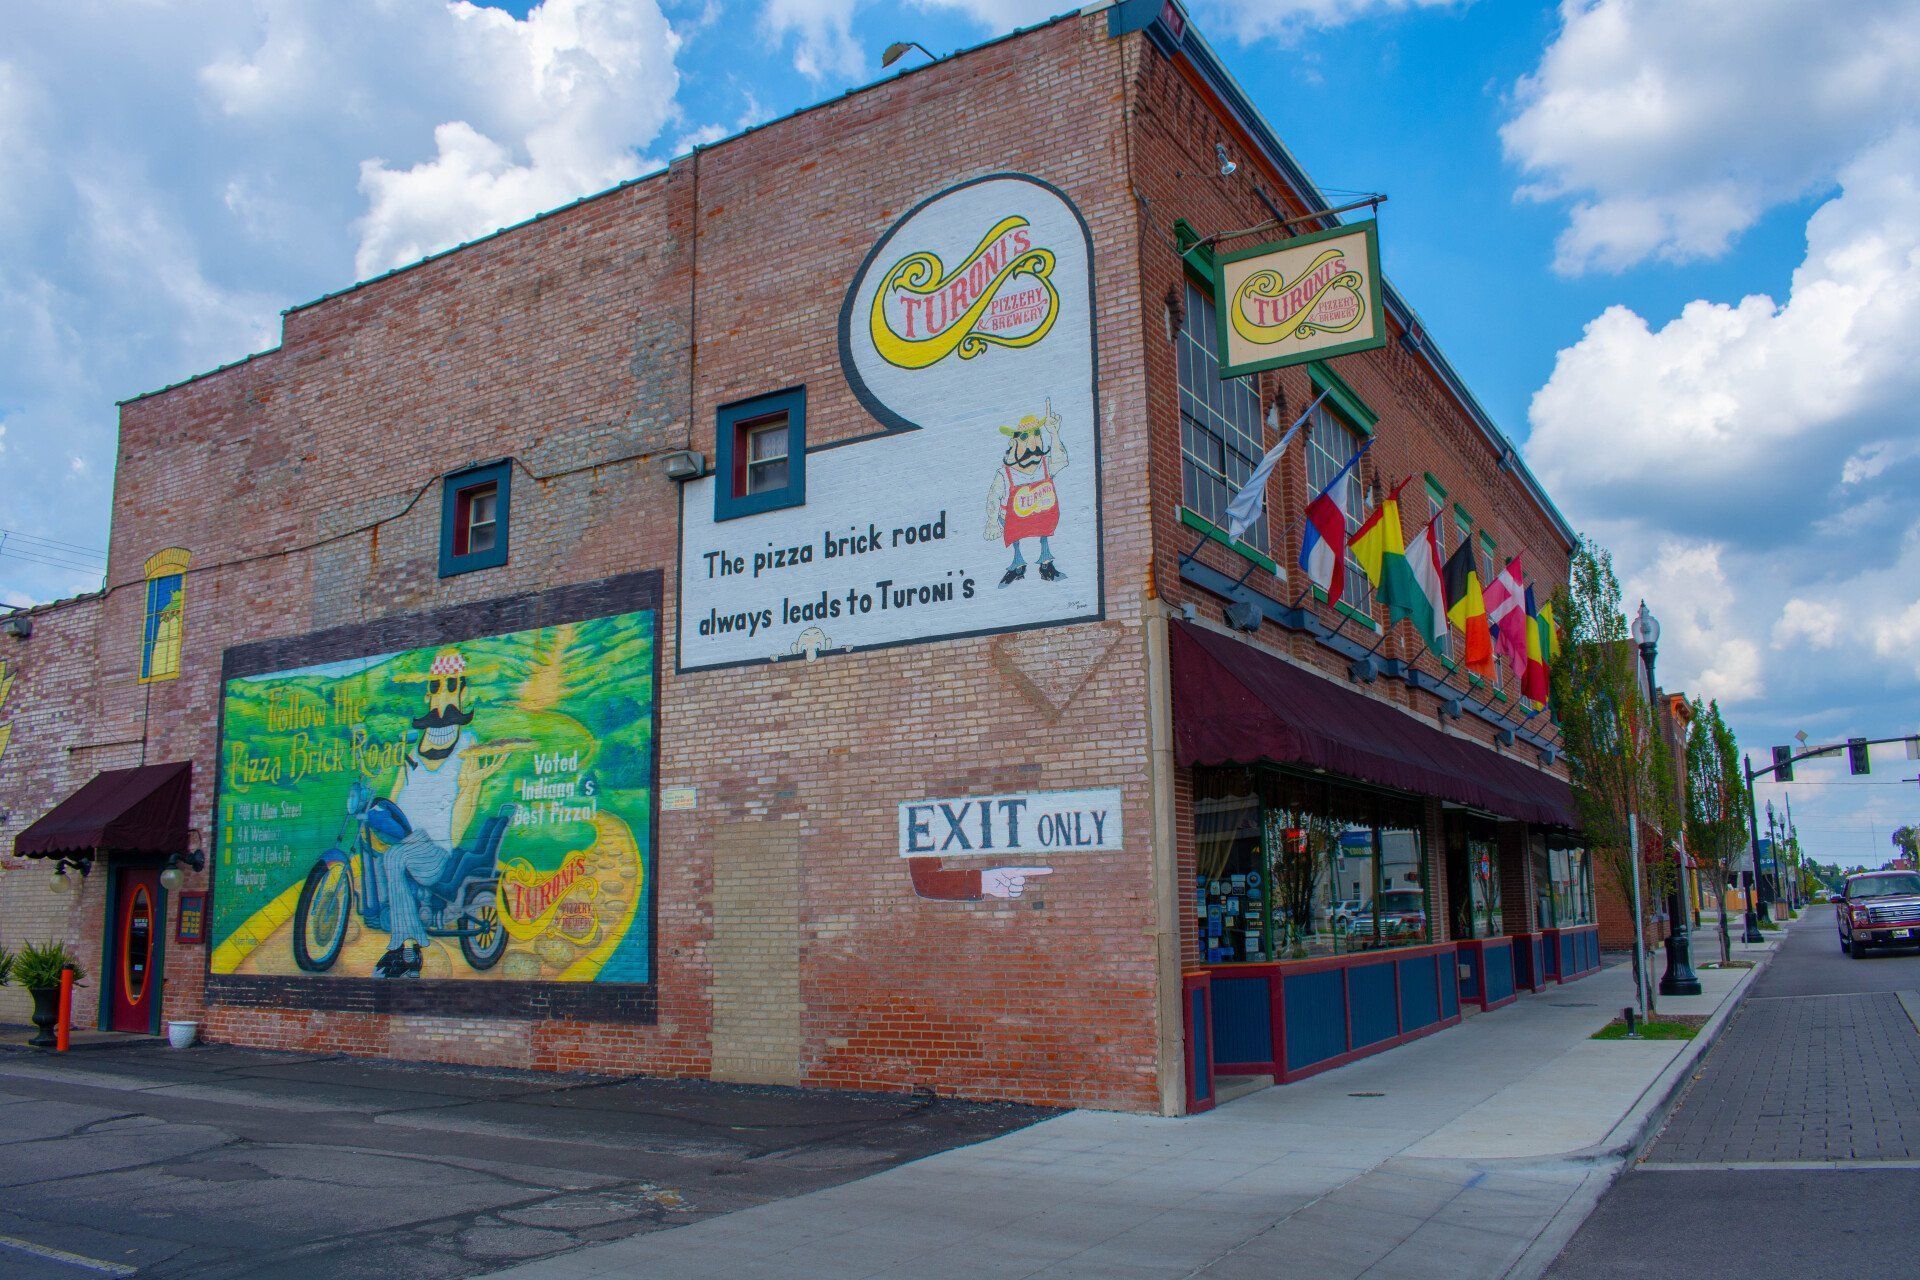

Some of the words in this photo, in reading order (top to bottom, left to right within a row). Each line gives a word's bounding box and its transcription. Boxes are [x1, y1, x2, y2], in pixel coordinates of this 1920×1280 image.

[900, 229, 1032, 339] TURONI'S
[990, 286, 1044, 316] PIZZERY
[1253, 258, 1347, 325] TURONI'S
[1318, 296, 1355, 313] PIZZERY
[977, 318, 989, 331] &
[991, 306, 1045, 332] BREWERY
[1319, 307, 1356, 323] BREWERY
[703, 550, 745, 579] The
[753, 542, 813, 578] pizza
[824, 523, 883, 559] brick
[892, 510, 946, 548] road
[699, 607, 772, 637] always
[783, 590, 841, 625] leads
[846, 588, 872, 615] to
[876, 569, 975, 610] Turoni's
[268, 687, 327, 733] Follow
[230, 740, 281, 793] Pizza
[290, 731, 344, 784] Brick
[351, 727, 407, 778] Road
[534, 750, 579, 775] Voted
[281, 800, 302, 818] Street
[513, 801, 545, 827] Best
[550, 799, 598, 824] Pizza!
[906, 799, 1027, 853] EXIT
[1038, 810, 1107, 847] ONLY
[513, 856, 586, 920] TURONI'S
